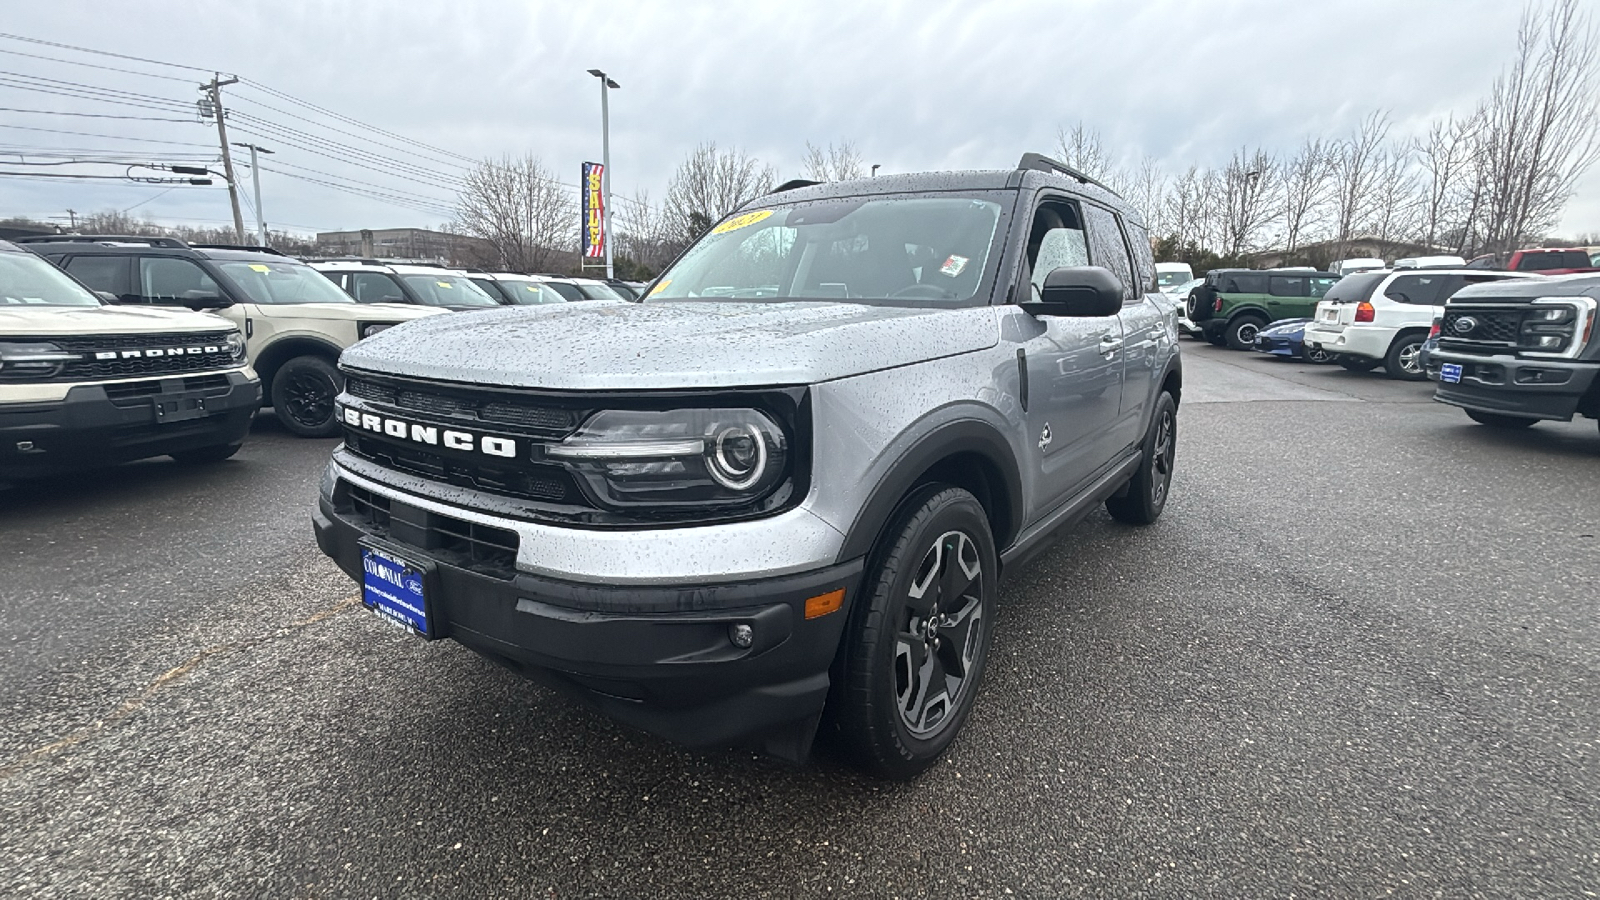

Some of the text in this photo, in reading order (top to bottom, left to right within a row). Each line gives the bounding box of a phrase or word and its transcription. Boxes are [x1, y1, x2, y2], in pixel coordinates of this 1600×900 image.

[588, 173, 601, 246] SALE
[95, 345, 219, 360] BRONCO
[344, 408, 516, 458] BRONCO
[364, 559, 404, 588] COLONIAL
